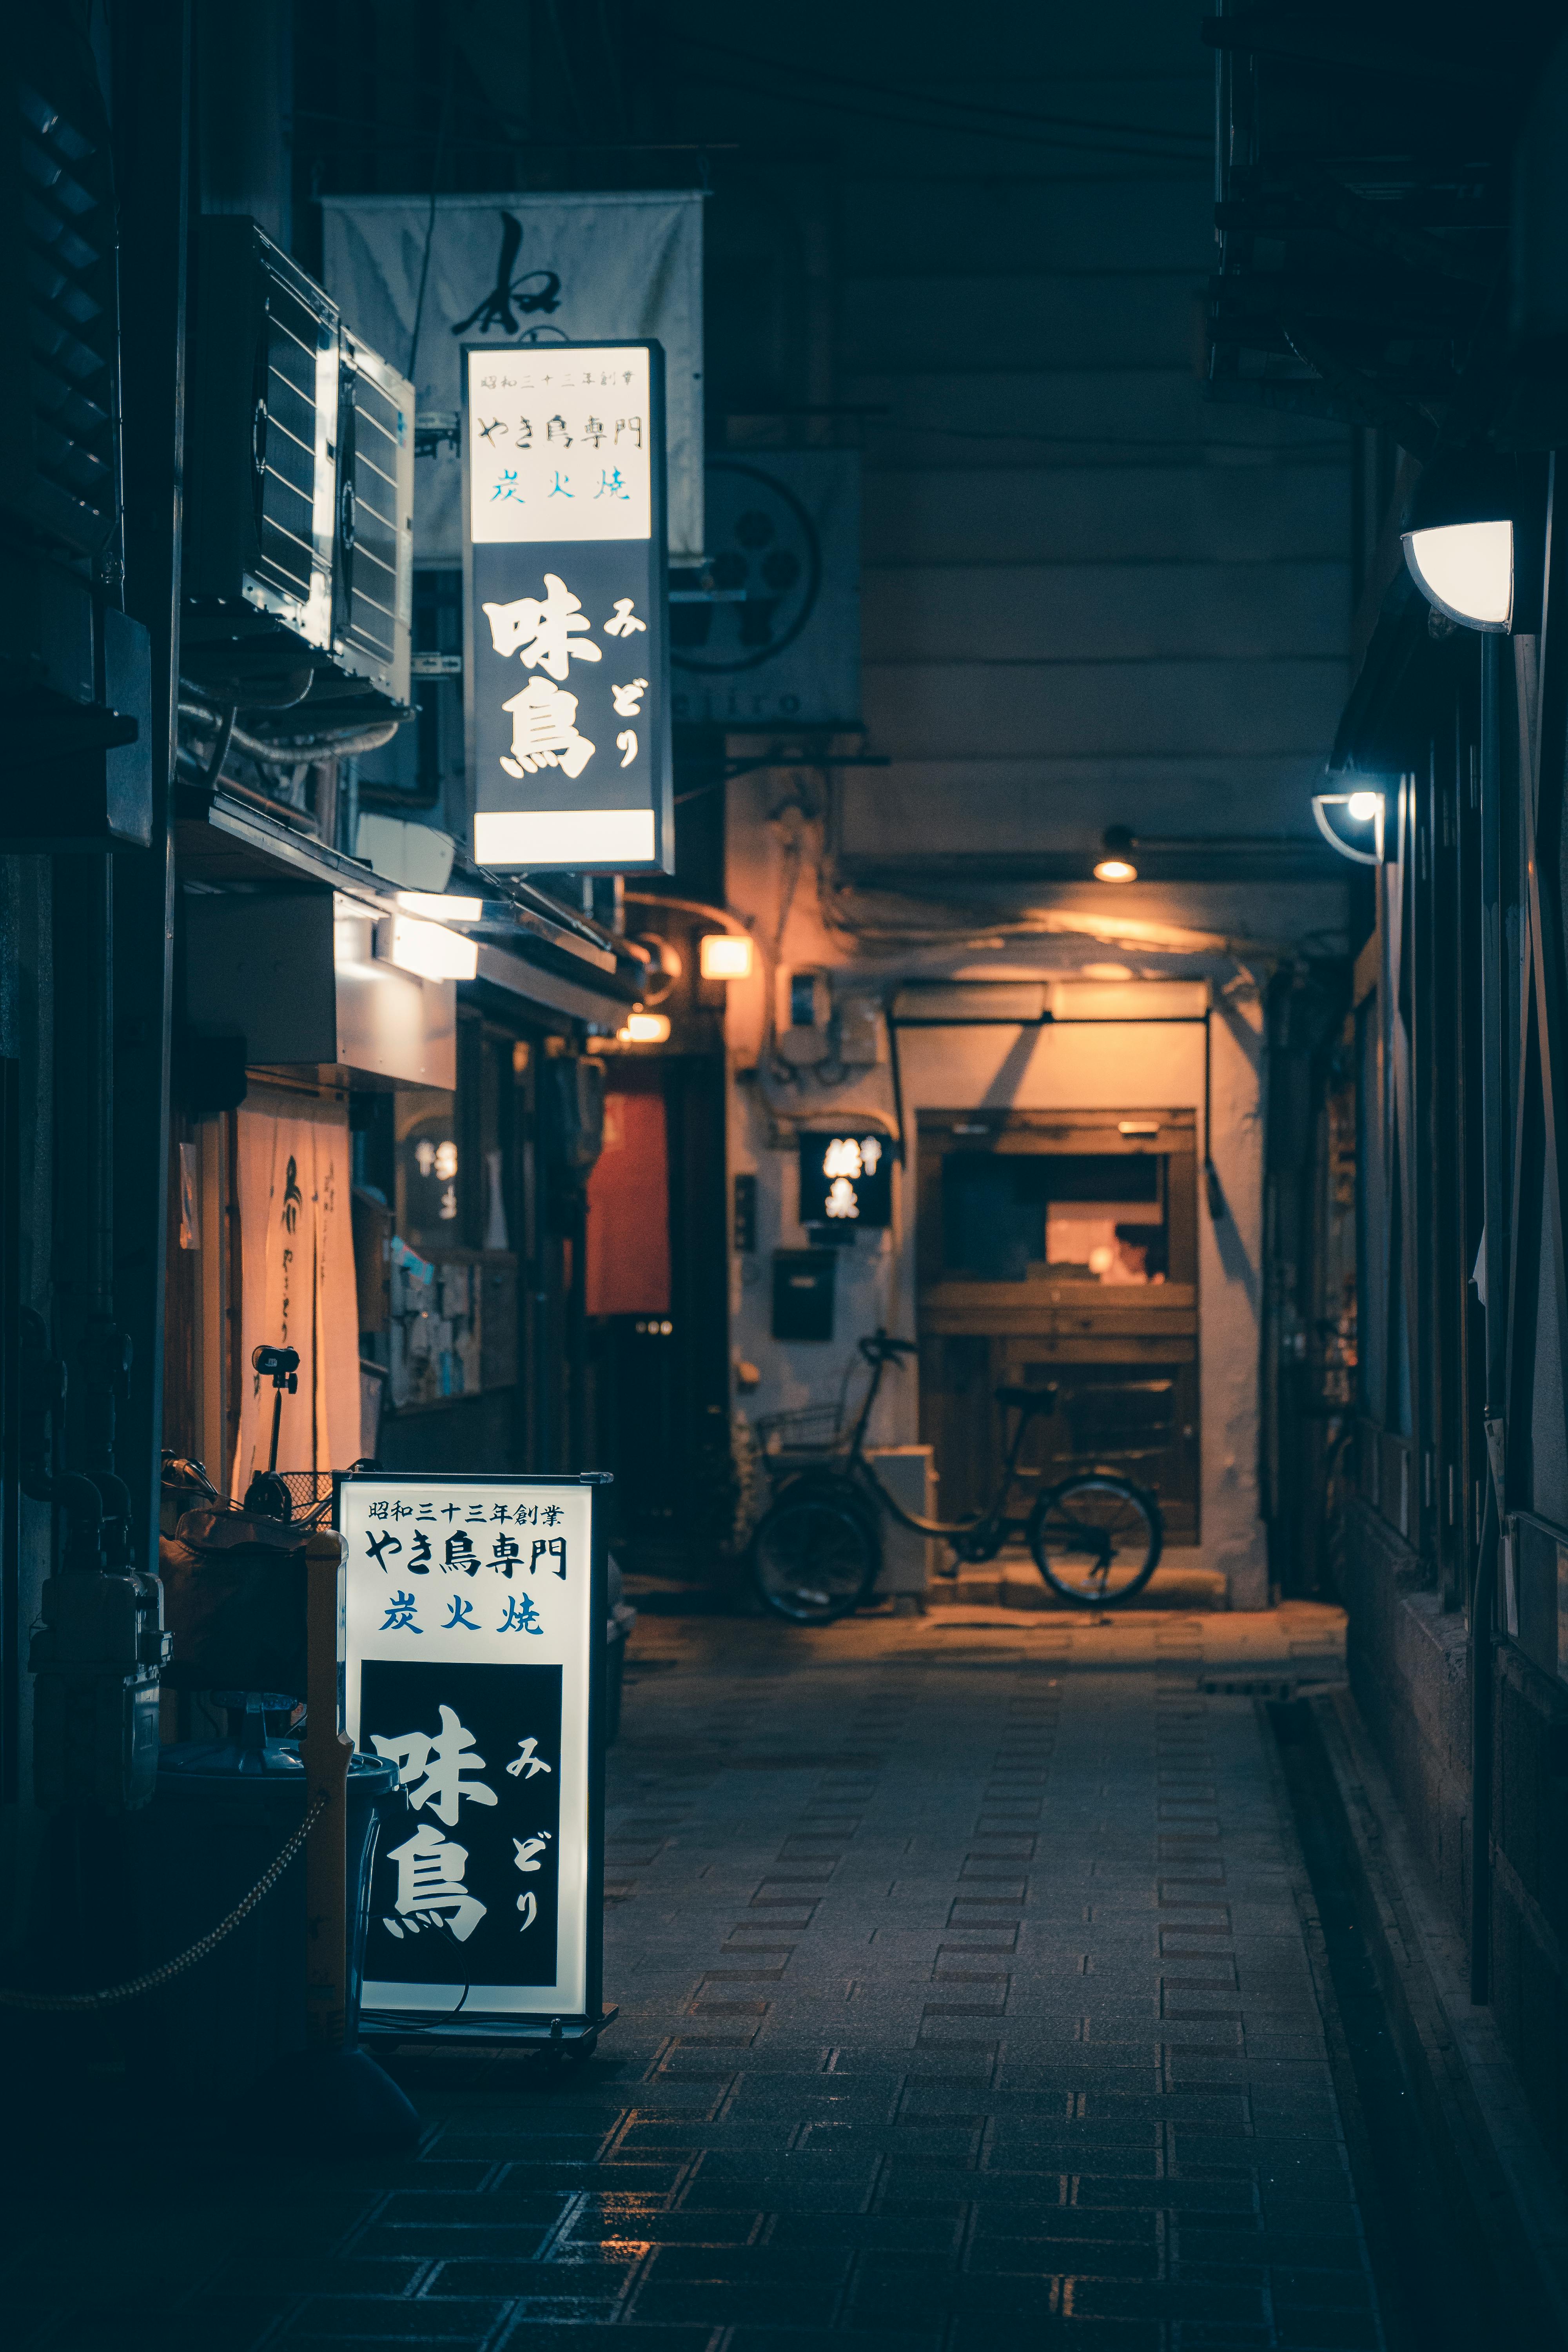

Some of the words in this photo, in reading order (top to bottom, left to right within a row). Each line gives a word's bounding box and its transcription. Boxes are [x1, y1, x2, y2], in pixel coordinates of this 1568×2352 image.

[477, 414, 642, 449] やき鳥専門
[490, 466, 630, 504] 炭火焼
[482, 573, 602, 779] 味鳥
[603, 598, 649, 768] みどり
[368, 1500, 565, 1526] 昭和三十三年創業
[365, 1529, 567, 1581] やき鳥専門
[378, 1590, 544, 1635] 炭火焼
[370, 1705, 498, 1942] 味鳥
[506, 1737, 552, 1932] みどり
